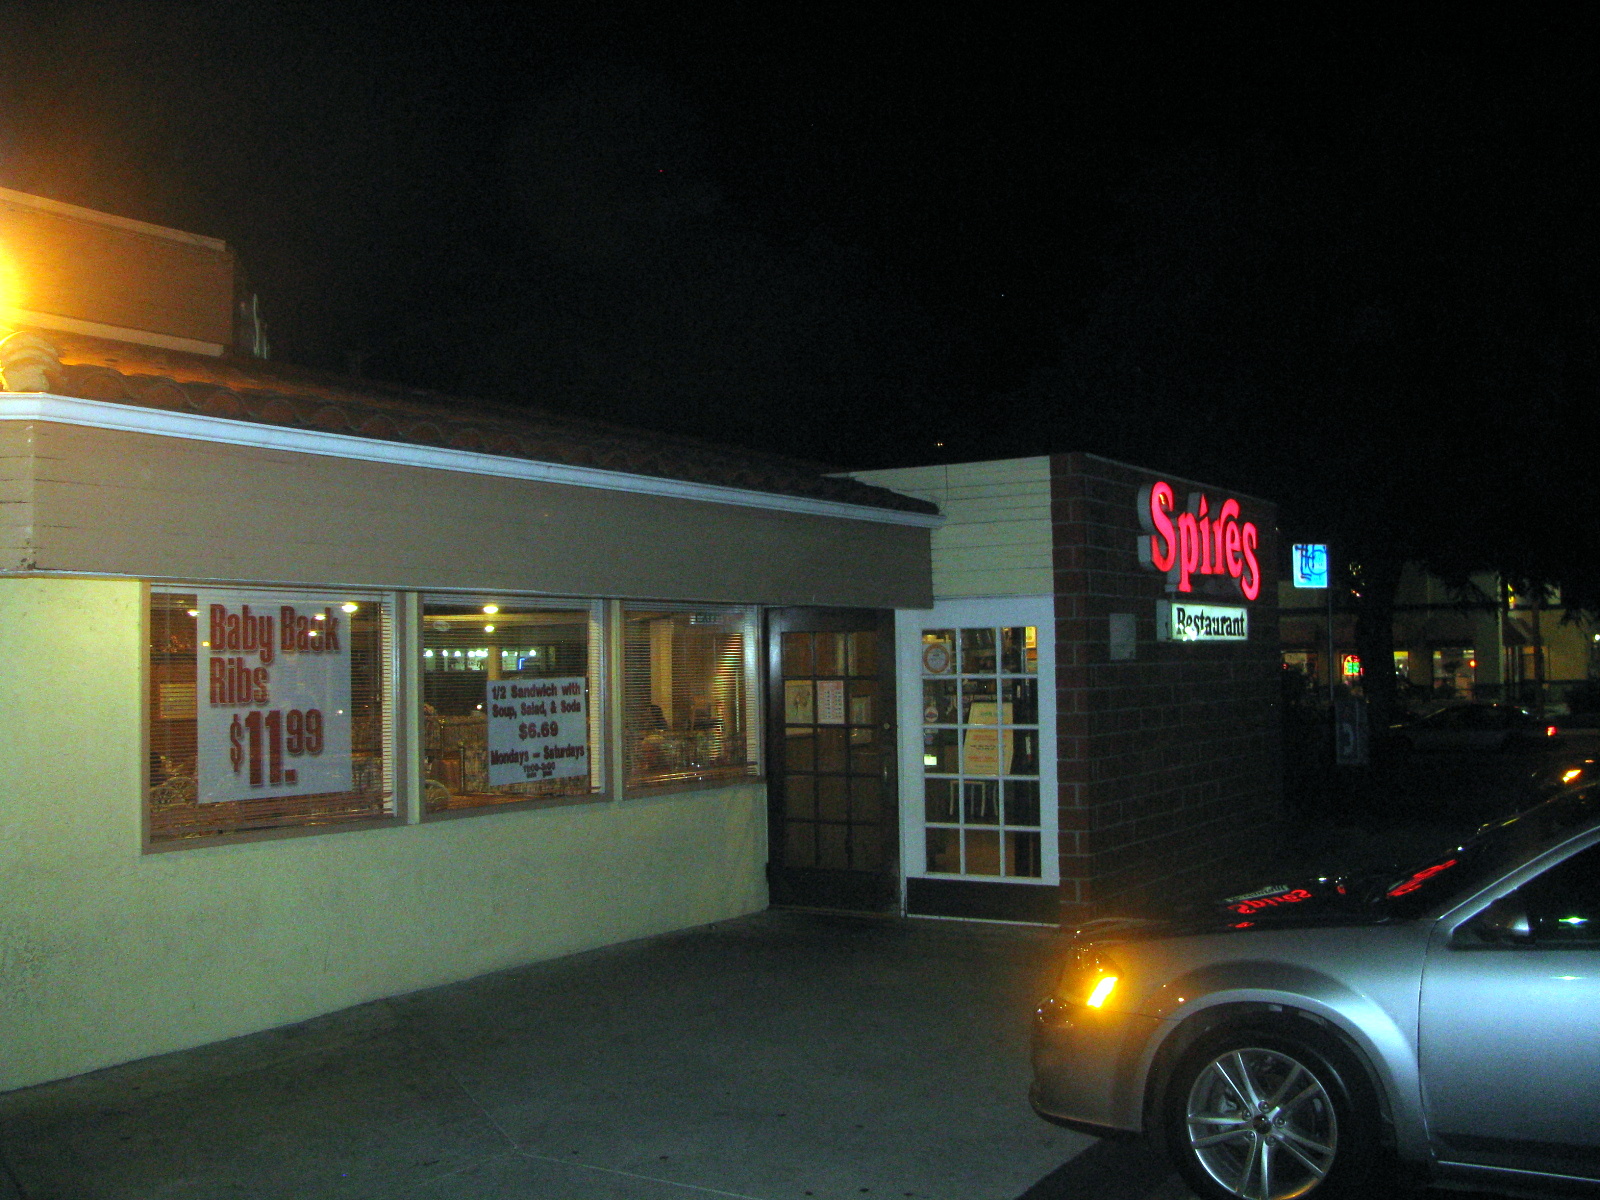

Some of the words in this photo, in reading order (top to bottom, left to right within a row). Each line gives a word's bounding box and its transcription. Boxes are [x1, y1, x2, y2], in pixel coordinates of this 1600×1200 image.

[1151, 481, 1261, 601] Spires
[209, 603, 274, 665] Baby
[280, 605, 341, 653] Back
[1176, 606, 1246, 638] Restaurant
[209, 657, 270, 705] Ribs
[491, 686, 507, 701] 1/2
[510, 683, 557, 699] Sandwich
[561, 682, 581, 696] with
[492, 703, 517, 720] Soup,
[520, 701, 547, 717] Salad,
[550, 700, 557, 714] &
[560, 699, 581, 713] Soda
[518, 720, 559, 741] $6.69
[229, 708, 324, 787] $11.99
[490, 747, 529, 766] Mondays
[543, 743, 585, 761] Saturdays
